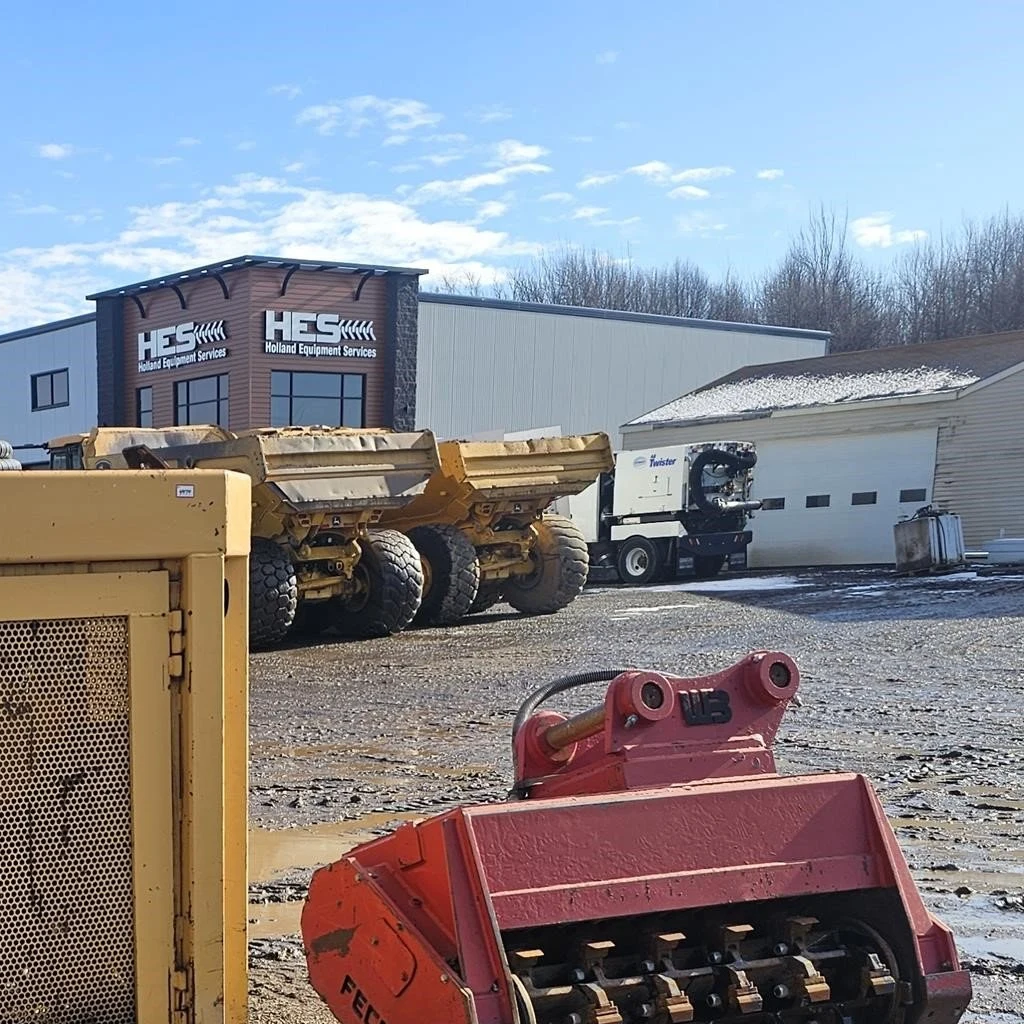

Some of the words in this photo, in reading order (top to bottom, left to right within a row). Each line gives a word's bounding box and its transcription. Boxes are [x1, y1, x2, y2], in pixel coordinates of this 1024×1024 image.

[265, 310, 341, 344] HES
[137, 321, 195, 361] HES
[265, 341, 296, 355] Holland
[299, 343, 341, 358] Equipment
[343, 345, 376, 358] Services
[138, 358, 161, 372] Holland
[163, 353, 196, 369] Equipment
[197, 347, 226, 362] Services
[649, 457, 676, 467] Twister
